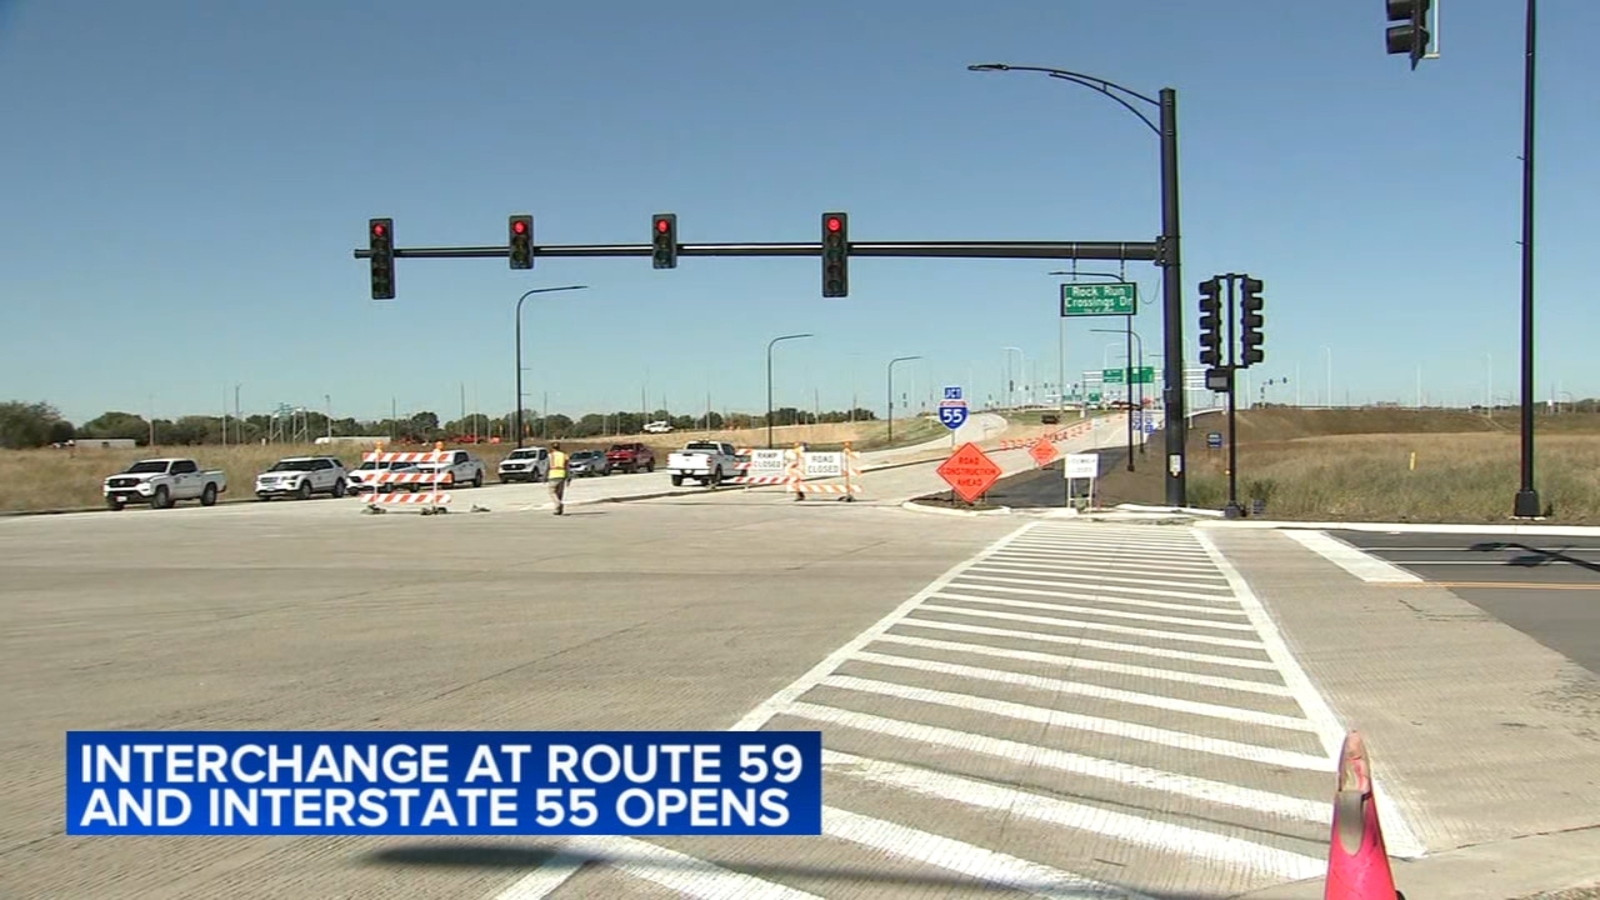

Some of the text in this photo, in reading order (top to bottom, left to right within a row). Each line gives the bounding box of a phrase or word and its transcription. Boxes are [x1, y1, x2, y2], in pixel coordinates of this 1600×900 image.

[1072, 285, 1126, 297] Rock Run
[1065, 296, 1115, 308] Crossings
[943, 409, 963, 423] 55
[812, 455, 834, 464] ROAD
[958, 457, 980, 466] ROAD
[753, 460, 781, 469] CLOSED
[807, 465, 840, 474] CLOSED
[940, 467, 997, 476] CONSTRUCTION
[956, 478, 984, 487] AHEAD
